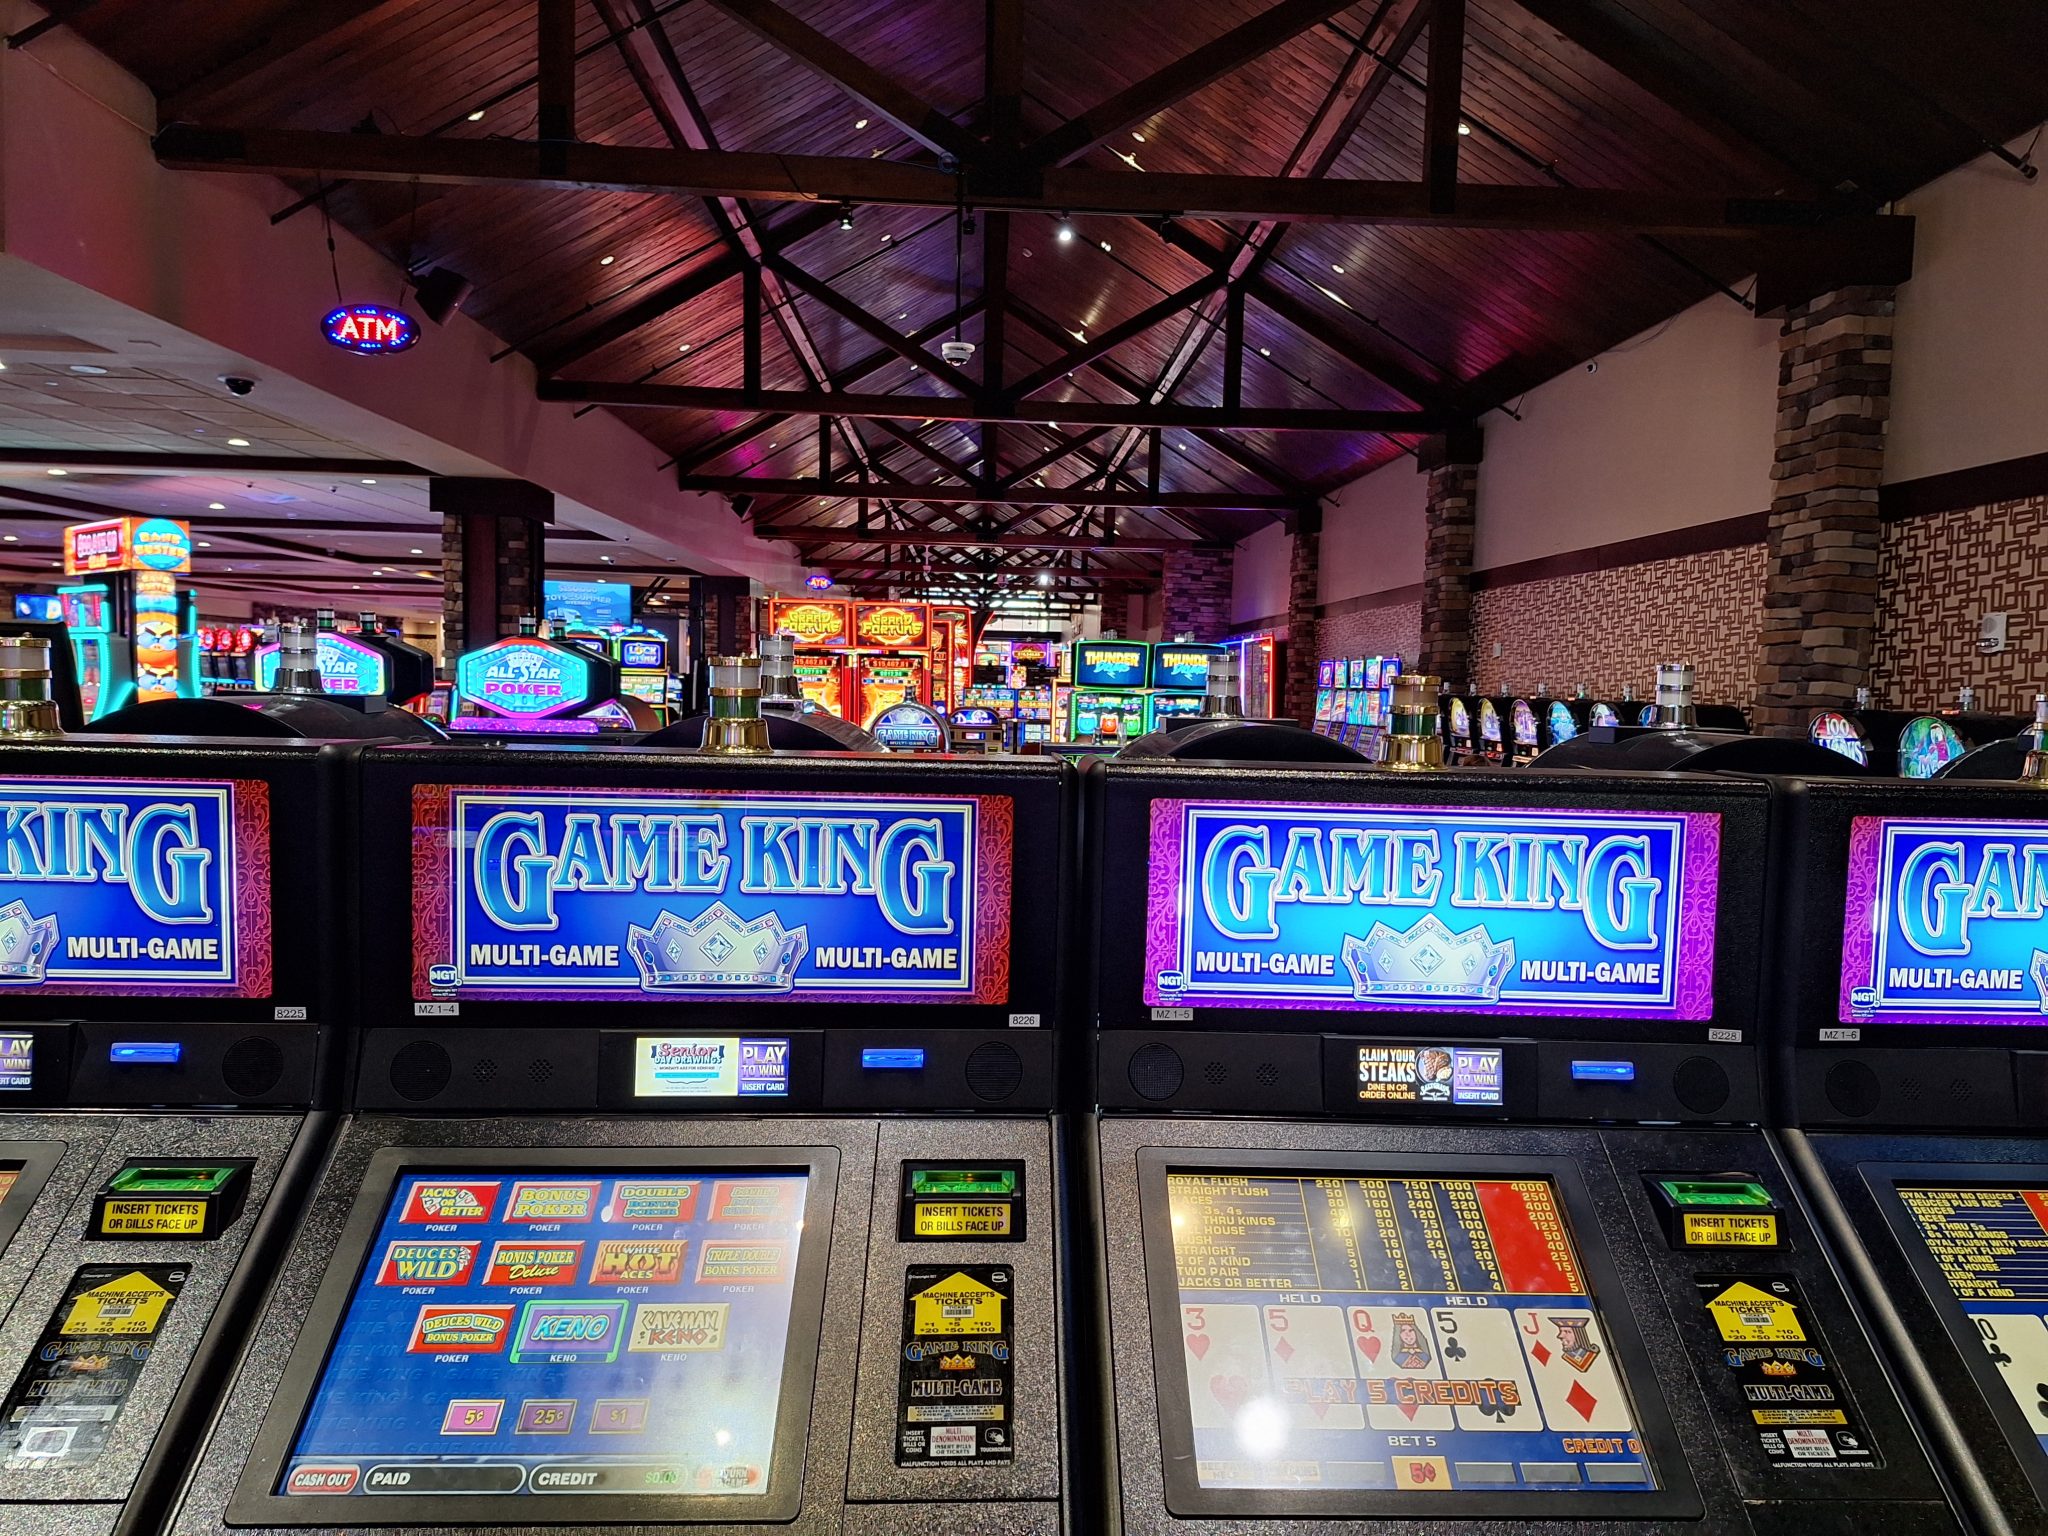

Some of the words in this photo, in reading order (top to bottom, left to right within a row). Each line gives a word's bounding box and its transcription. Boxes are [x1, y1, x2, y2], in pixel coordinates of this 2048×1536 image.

[340, 317, 396, 340] ATM
[575, 595, 611, 603] SUMMER
[789, 612, 831, 622] GRAND
[871, 614, 913, 624] GRAND
[780, 621, 841, 633] FORTUNE
[862, 623, 923, 635] FORTUNE
[1085, 651, 1139, 667] THUNDER
[1163, 653, 1208, 667] THUNDE
[486, 662, 560, 682] ALL-STAR
[485, 683, 562, 696] POKER
[1825, 715, 1850, 736] 100
[0, 802, 212, 924] KING
[474, 811, 731, 932] GAME
[740, 817, 955, 935] KING
[1202, 824, 1443, 940] GAME
[1451, 832, 1662, 950] KING
[67, 937, 218, 960] MULTI-GAME
[470, 944, 619, 967] MULTI-GAME
[815, 947, 957, 970] MULTI-GAME
[1196, 951, 1335, 976] MULTI-GAME
[1521, 960, 1660, 984] MULTI-GAME
[1889, 968, 2023, 989] MULTI-GAME
[276, 1008, 304, 1018] 8225
[419, 1005, 435, 1014] MZ
[1157, 1010, 1172, 1018] MZ
[1012, 1016, 1035, 1025] 8226
[1712, 1031, 1738, 1040] 8228
[1824, 1031, 1838, 1039] MZ
[659, 1043, 717, 1057] Senior
[743, 1047, 787, 1064] PLAY
[1359, 1049, 1388, 1061] CLAIM
[1390, 1050, 1415, 1062] YOUR
[3, 1059, 30, 1070] WIN!
[654, 1056, 672, 1064] DAY
[1458, 1057, 1499, 1073] PLAY
[742, 1065, 754, 1075] TO
[758, 1065, 784, 1076] WIN!
[1360, 1062, 1416, 1082] STEAKS
[11, 1077, 30, 1085] CARD
[1457, 1075, 1470, 1085] TO
[1474, 1075, 1497, 1085] WIN!
[1368, 1083, 1386, 1091] DINE
[1211, 1178, 1248, 1186] FLUSH
[1511, 1183, 1544, 1191] 4000
[420, 1188, 458, 1198] JACKS
[520, 1189, 590, 1201] BONUS
[622, 1187, 689, 1198] DOUBLE
[1231, 1188, 1269, 1196] FLUSH
[112, 1204, 152, 1214] INSERT
[155, 1204, 199, 1215] TICKETS
[627, 1200, 679, 1208] BONUS
[440, 1207, 484, 1216] BETTER
[514, 1204, 588, 1217] POKER
[625, 1208, 678, 1216] POKER
[922, 1207, 958, 1217] INSERT
[962, 1207, 1003, 1217] TICKETS
[109, 1219, 123, 1229] OR
[126, 1219, 154, 1229] BILLS
[156, 1219, 181, 1229] FACE
[184, 1220, 198, 1230] UP
[921, 1221, 933, 1231] OR
[937, 1221, 963, 1231] BILLS
[966, 1221, 988, 1231] FACE
[992, 1221, 1004, 1231] UP
[1238, 1217, 1275, 1225] KINGS
[1690, 1218, 1725, 1227] INSERT
[1729, 1219, 1769, 1228] TICKETS
[1691, 1232, 1704, 1241] OR
[1706, 1232, 1731, 1241] BILLS
[1734, 1233, 1757, 1241] FACE
[1759, 1233, 1770, 1242] UP
[394, 1248, 456, 1259] DEUCES
[498, 1251, 534, 1263] BONUS
[536, 1252, 574, 1263] POKER
[603, 1252, 678, 1273] HOT
[398, 1261, 457, 1278] WILD
[508, 1266, 560, 1279] Deluxe
[620, 1270, 653, 1279] ACES
[705, 1266, 740, 1275] BONUS
[742, 1266, 777, 1275] POKER
[1178, 1278, 1221, 1287] JACKS
[1225, 1278, 1243, 1287] OR
[1246, 1279, 1292, 1288] BETTER
[402, 1287, 435, 1295] POKER
[1280, 1294, 1321, 1304] HELD
[1447, 1297, 1488, 1306] HELD
[424, 1316, 471, 1332] DEUCES
[473, 1316, 503, 1331] WILD
[642, 1310, 719, 1331] CAVEMAN
[531, 1315, 610, 1341] KENO
[426, 1333, 459, 1341] BONUS
[460, 1333, 493, 1341] POKER
[649, 1329, 708, 1345] KENO
[906, 1341, 959, 1361] GAME
[963, 1341, 1009, 1360] KING
[435, 1355, 469, 1363] POKER
[1723, 1348, 1774, 1367] GAME
[1775, 1348, 1826, 1367] KING
[911, 1379, 1002, 1397] MULTI-GAME
[1284, 1380, 1357, 1404] PLAY
[1367, 1381, 1387, 1404] 5
[1395, 1380, 1520, 1405] CREDITS
[1744, 1385, 1834, 1400] MULTI-GAME
[465, 1409, 484, 1425] 5¢
[534, 1409, 564, 1425] 25¢
[610, 1408, 628, 1424] $1
[1388, 1435, 1424, 1447] BET
[1426, 1437, 1437, 1447] 5
[1562, 1438, 1622, 1454] CREDIT
[295, 1474, 324, 1486] CASH
[327, 1474, 351, 1486] OUT
[371, 1472, 410, 1485] PAID
[538, 1472, 597, 1485] CREDIT
